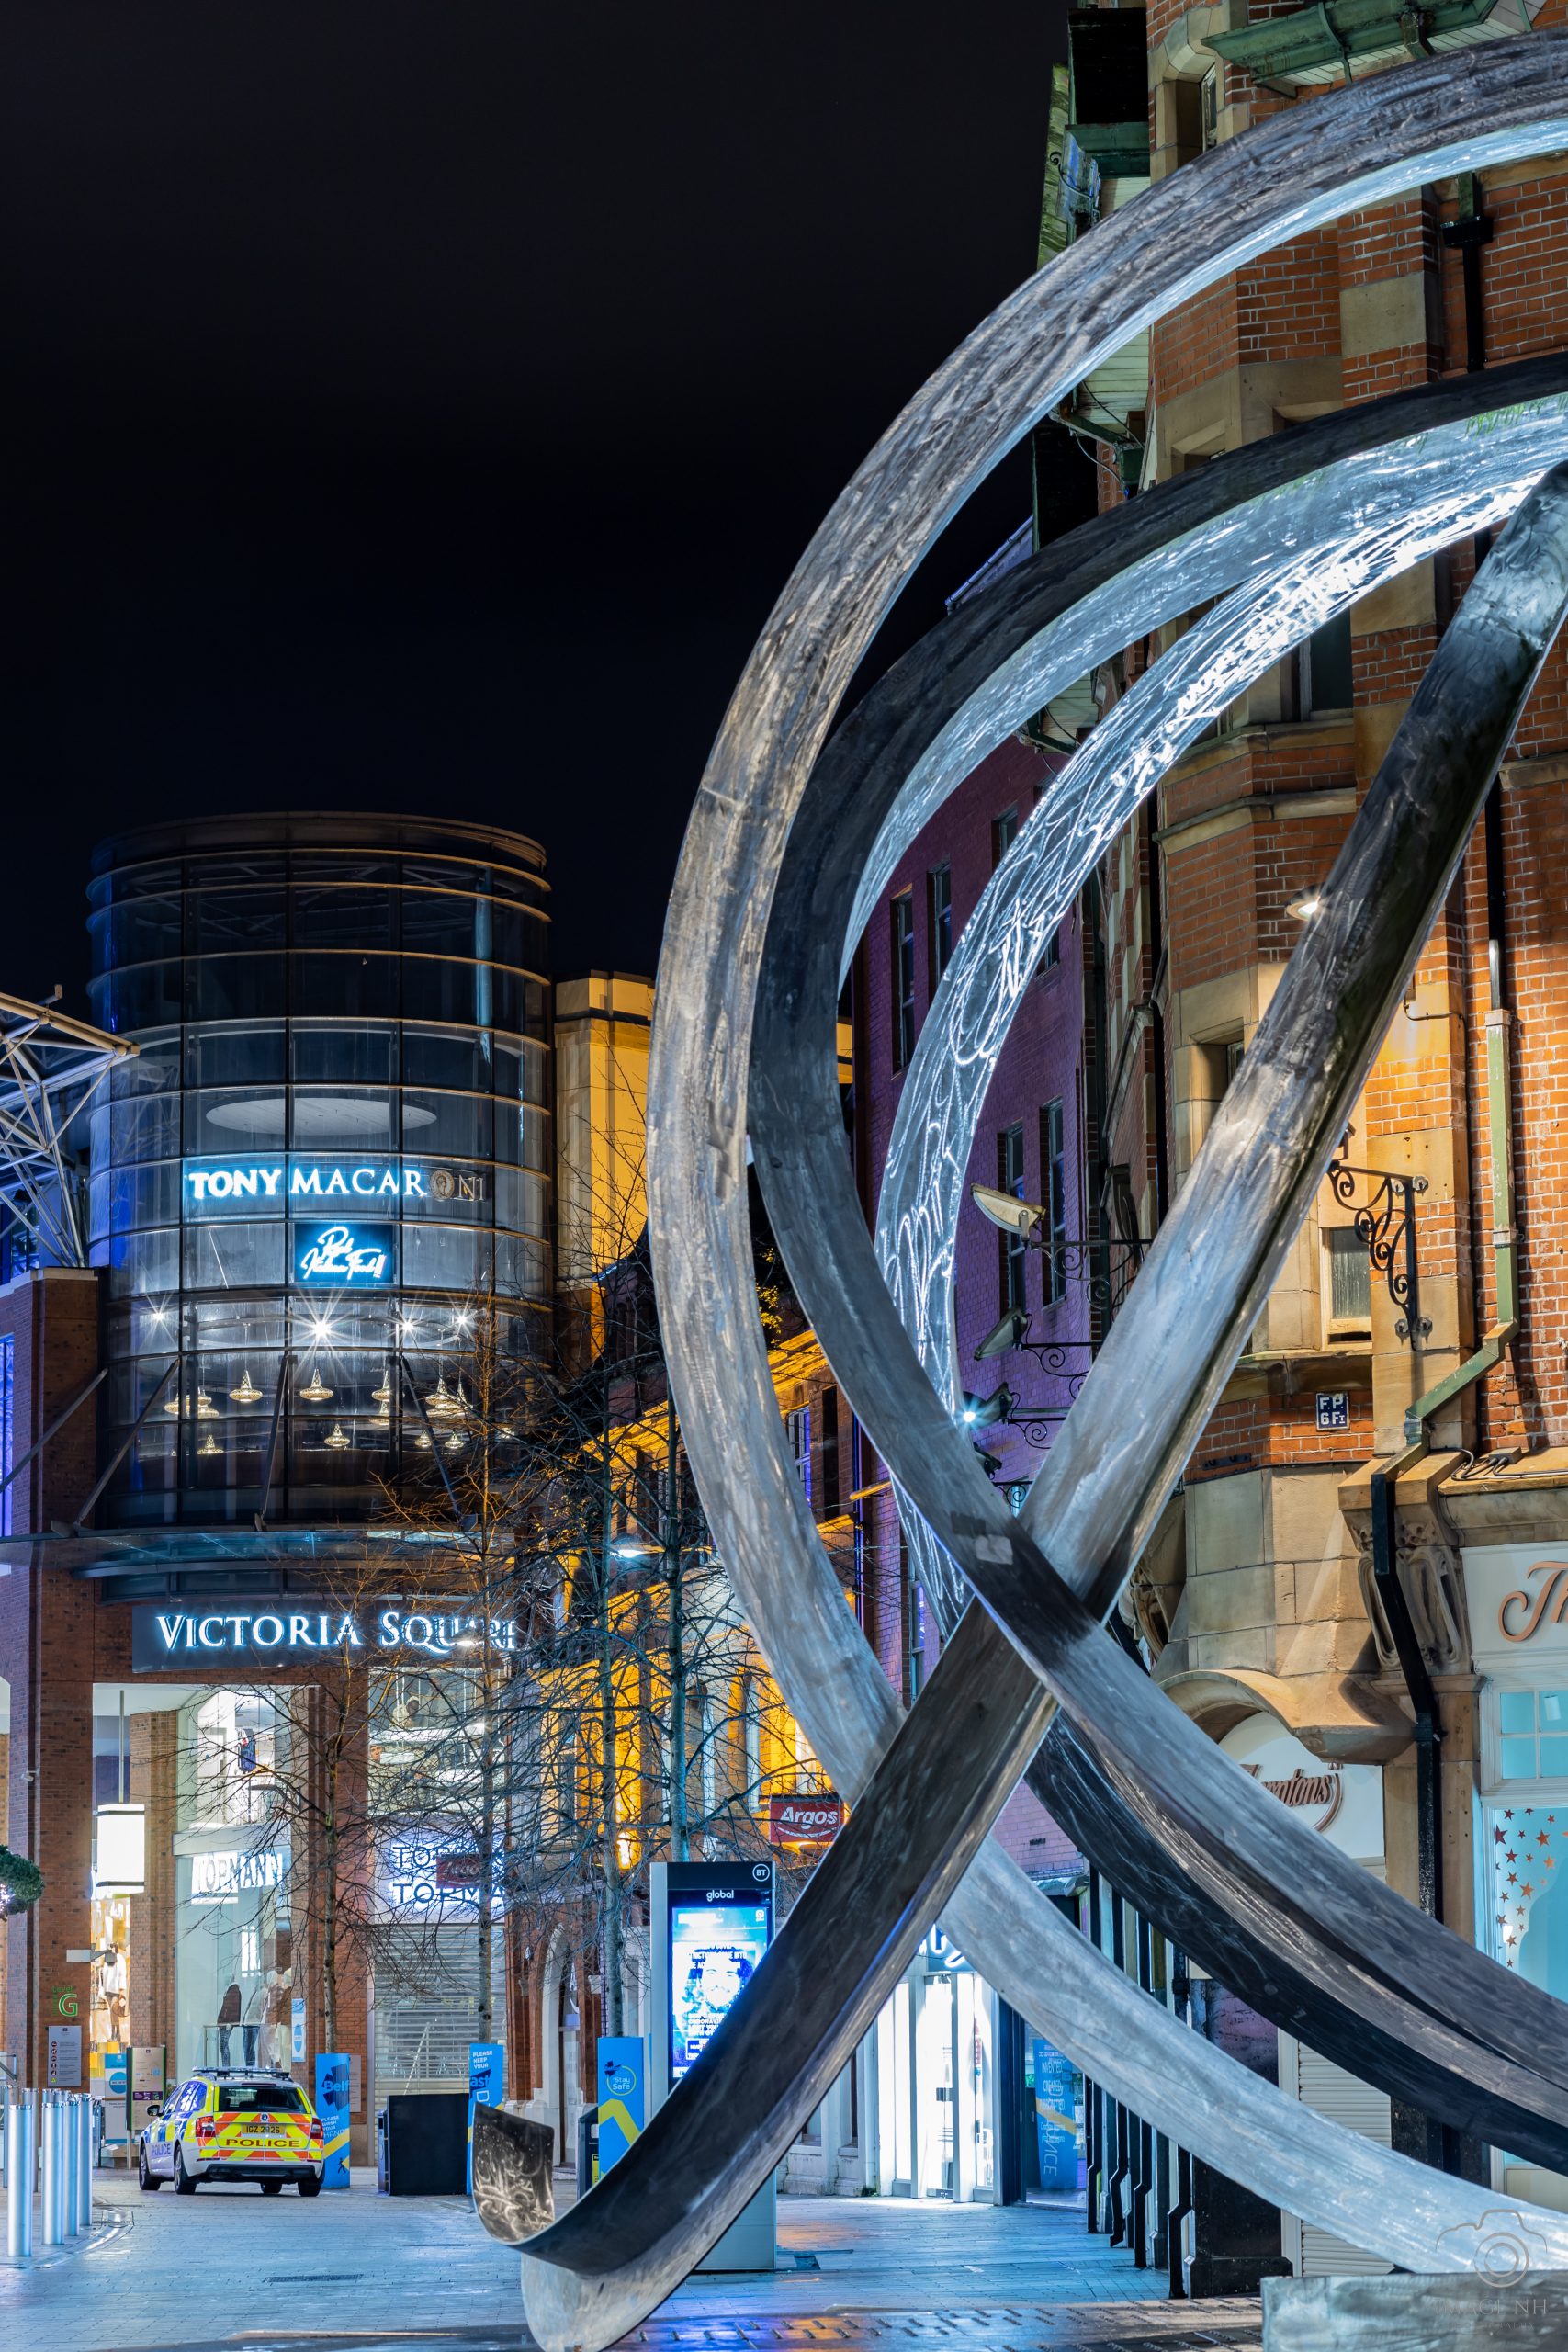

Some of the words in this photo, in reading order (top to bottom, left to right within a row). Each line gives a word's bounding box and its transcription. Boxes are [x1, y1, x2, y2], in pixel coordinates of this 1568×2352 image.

[188, 1170, 281, 1199] TONY
[290, 1169, 485, 1202] MACARONI
[156, 1614, 362, 1650] VICTORIA
[780, 1806, 839, 1830] Argos
[706, 1889, 735, 1902] global
[58, 1993, 78, 2017] G
[472, 2050, 493, 2058] PLEASE
[246, 2125, 259, 2133] IGZ
[225, 2139, 300, 2148] POLICE
